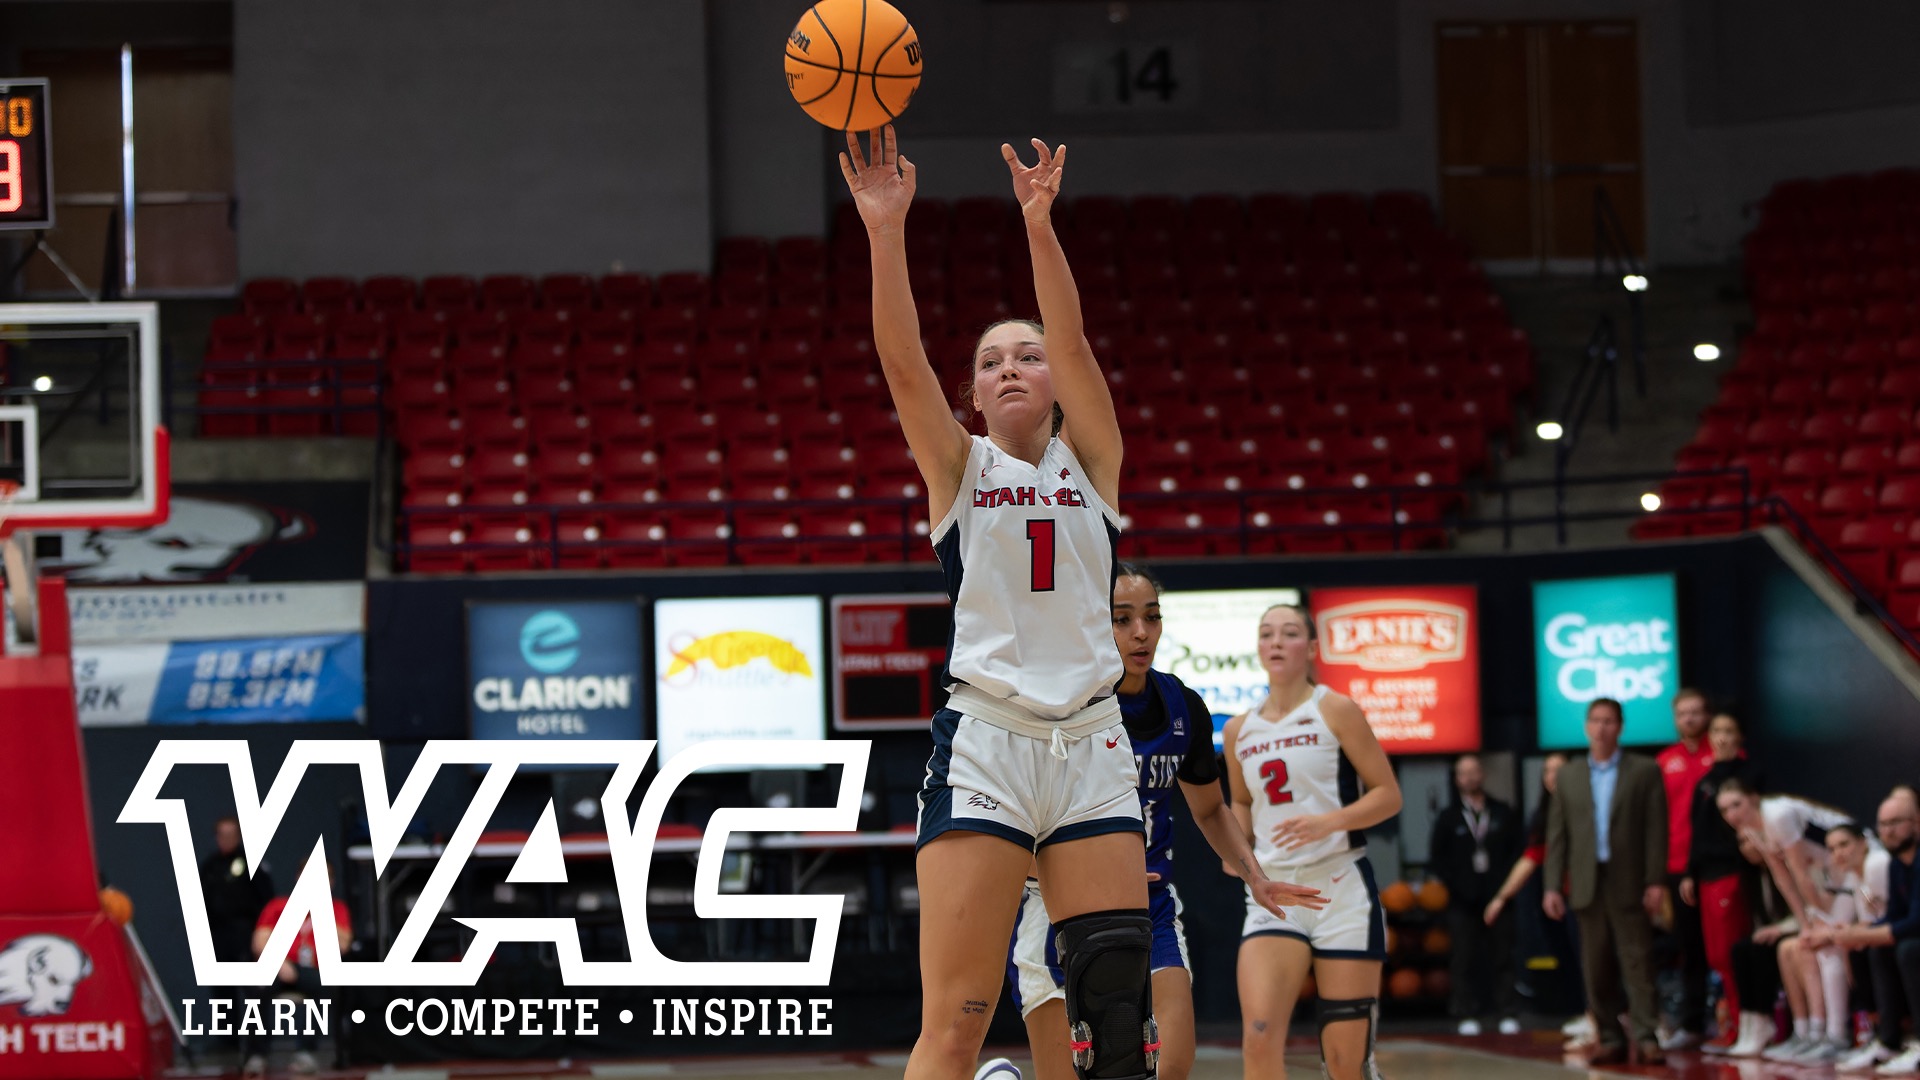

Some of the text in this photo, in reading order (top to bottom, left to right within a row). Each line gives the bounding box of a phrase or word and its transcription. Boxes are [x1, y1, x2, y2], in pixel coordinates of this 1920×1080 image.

[973, 486, 1036, 508] UTAH
[1026, 519, 1056, 592] 1
[1331, 613, 1456, 652] ERNIE'S
[1544, 613, 1671, 658] Great
[1170, 643, 1262, 675] Powe
[474, 675, 632, 713] CLARION
[1557, 658, 1664, 703] Clips
[517, 713, 586, 735] HOTEL
[1274, 733, 1318, 750] TECH
[1148, 755, 1184, 788] STAT
[1260, 758, 1293, 805] 2
[30, 1021, 125, 1053] TECH
